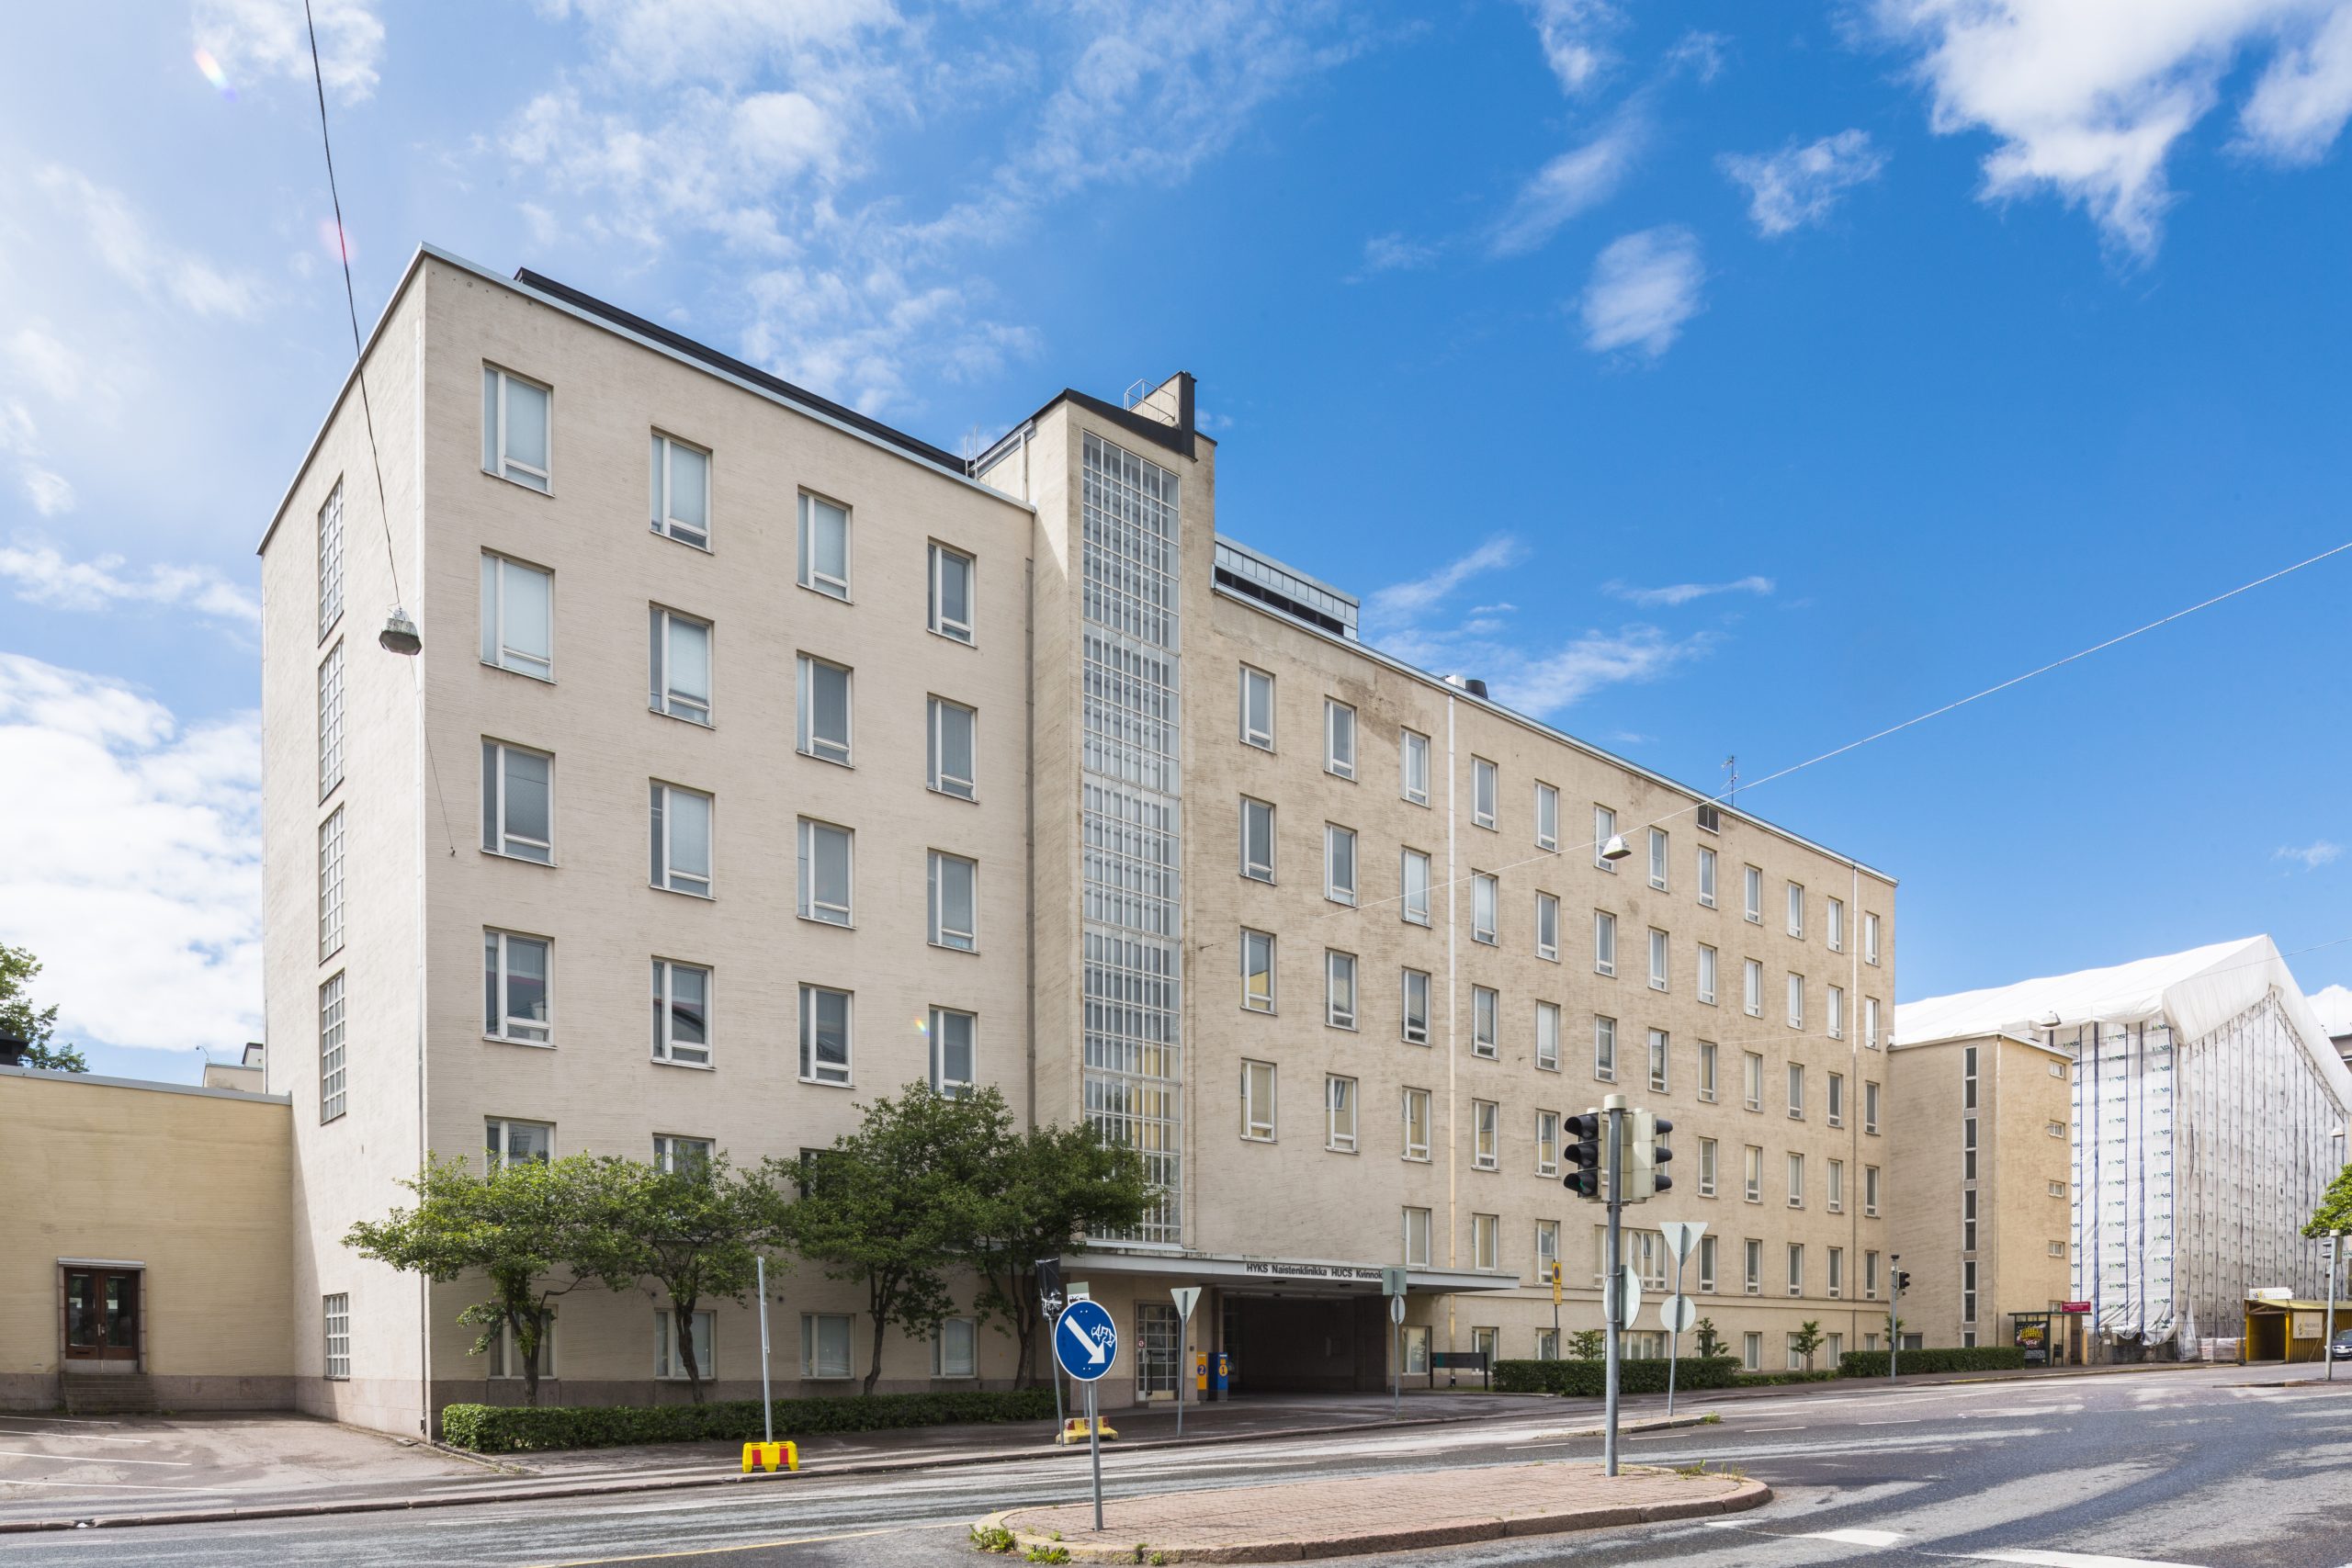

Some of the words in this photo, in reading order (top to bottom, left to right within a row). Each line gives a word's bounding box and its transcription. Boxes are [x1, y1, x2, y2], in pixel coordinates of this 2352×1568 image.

[1246, 1263, 1268, 1273] HYKS
[1272, 1264, 1328, 1277] Naistenklinikka
[1331, 1268, 1352, 1278] HUCS
[1356, 1269, 1383, 1280] Kvinnok
